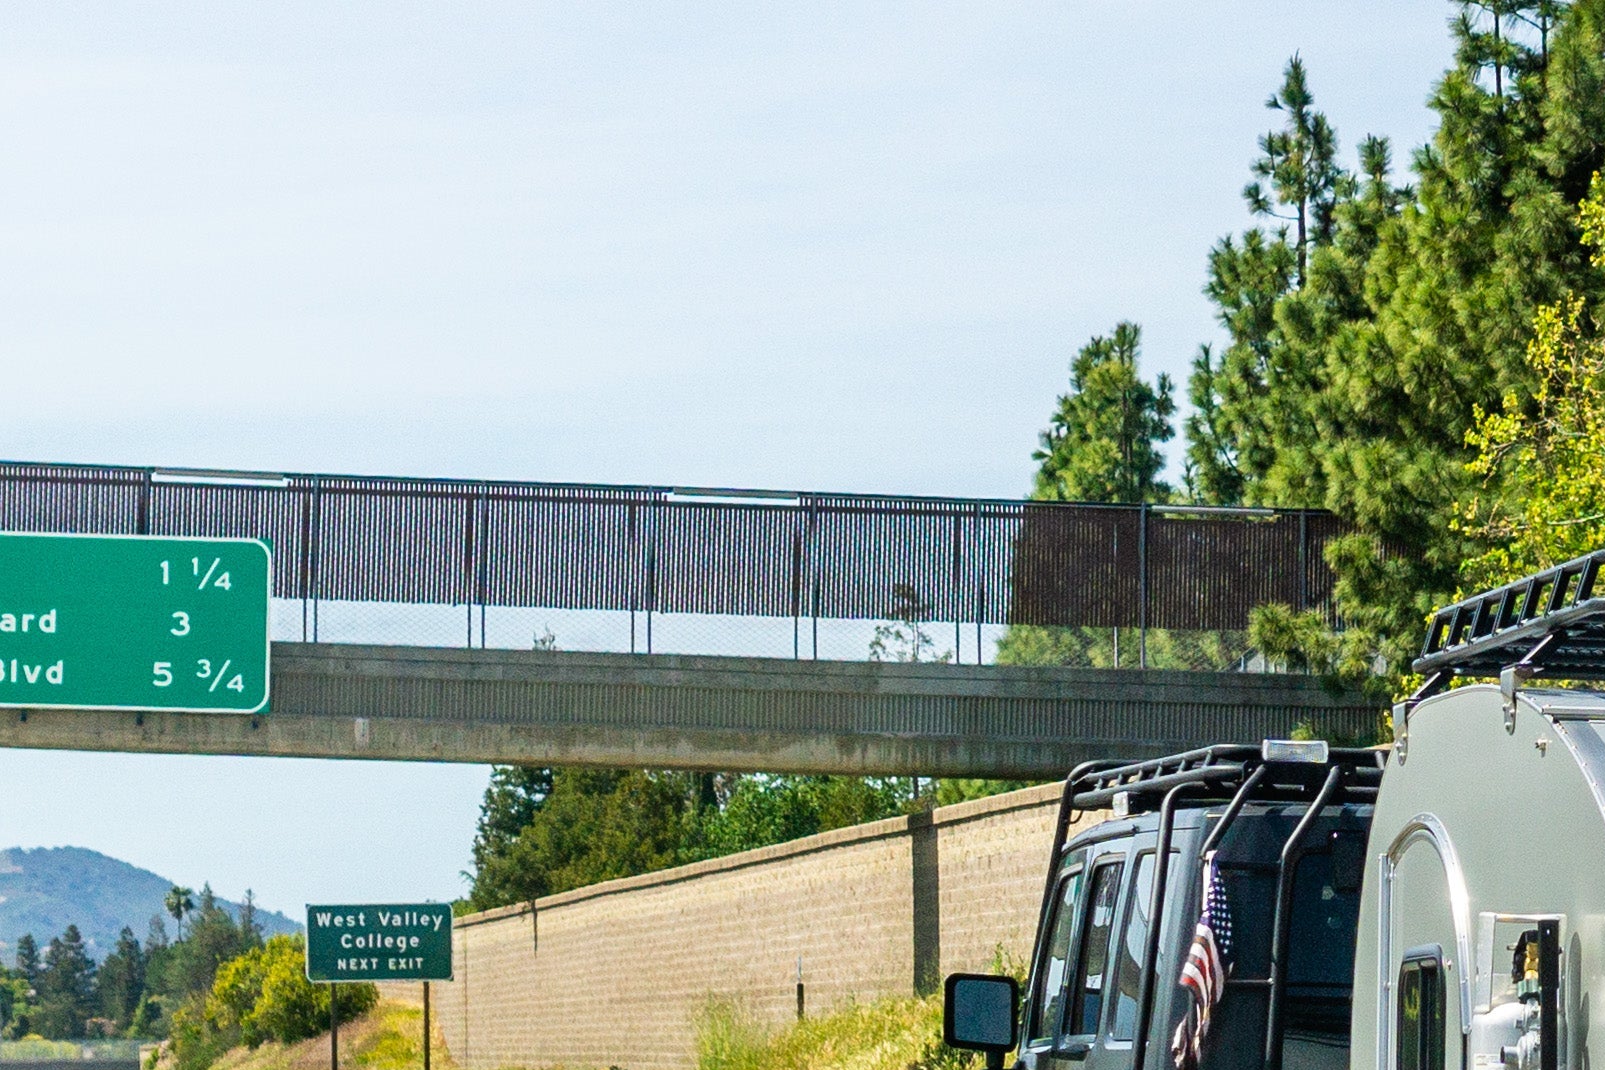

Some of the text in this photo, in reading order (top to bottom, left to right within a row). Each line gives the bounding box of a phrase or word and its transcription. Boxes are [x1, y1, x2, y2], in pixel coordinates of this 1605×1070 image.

[160, 560, 170, 585] 1
[0, 608, 190, 636] ard 3
[153, 662, 173, 687] 5
[316, 911, 443, 932] West Valley
[340, 933, 420, 953] College
[337, 957, 424, 970] NEXT EXIT
